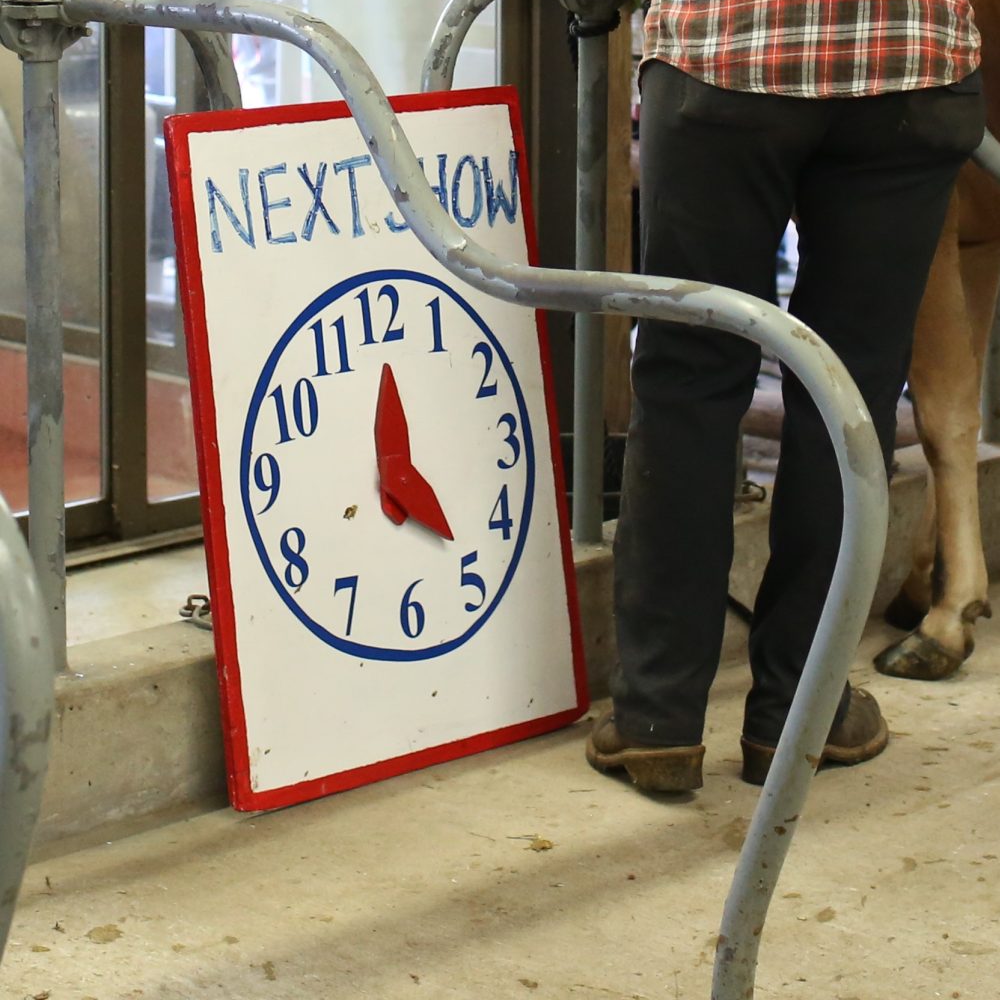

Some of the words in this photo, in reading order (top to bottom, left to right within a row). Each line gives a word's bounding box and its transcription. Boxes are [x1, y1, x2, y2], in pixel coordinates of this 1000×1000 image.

[205, 154, 372, 253] NEXT
[354, 284, 405, 346] 12
[425, 296, 448, 353] 1
[307, 315, 356, 378] 11
[471, 341, 498, 399] 2
[267, 377, 319, 446] 10
[496, 412, 521, 469] 3
[253, 453, 281, 516] 9
[488, 484, 514, 541] 4
[280, 527, 309, 588] 8
[460, 550, 487, 612] 5
[333, 575, 359, 637] 7
[400, 578, 425, 639] 6
